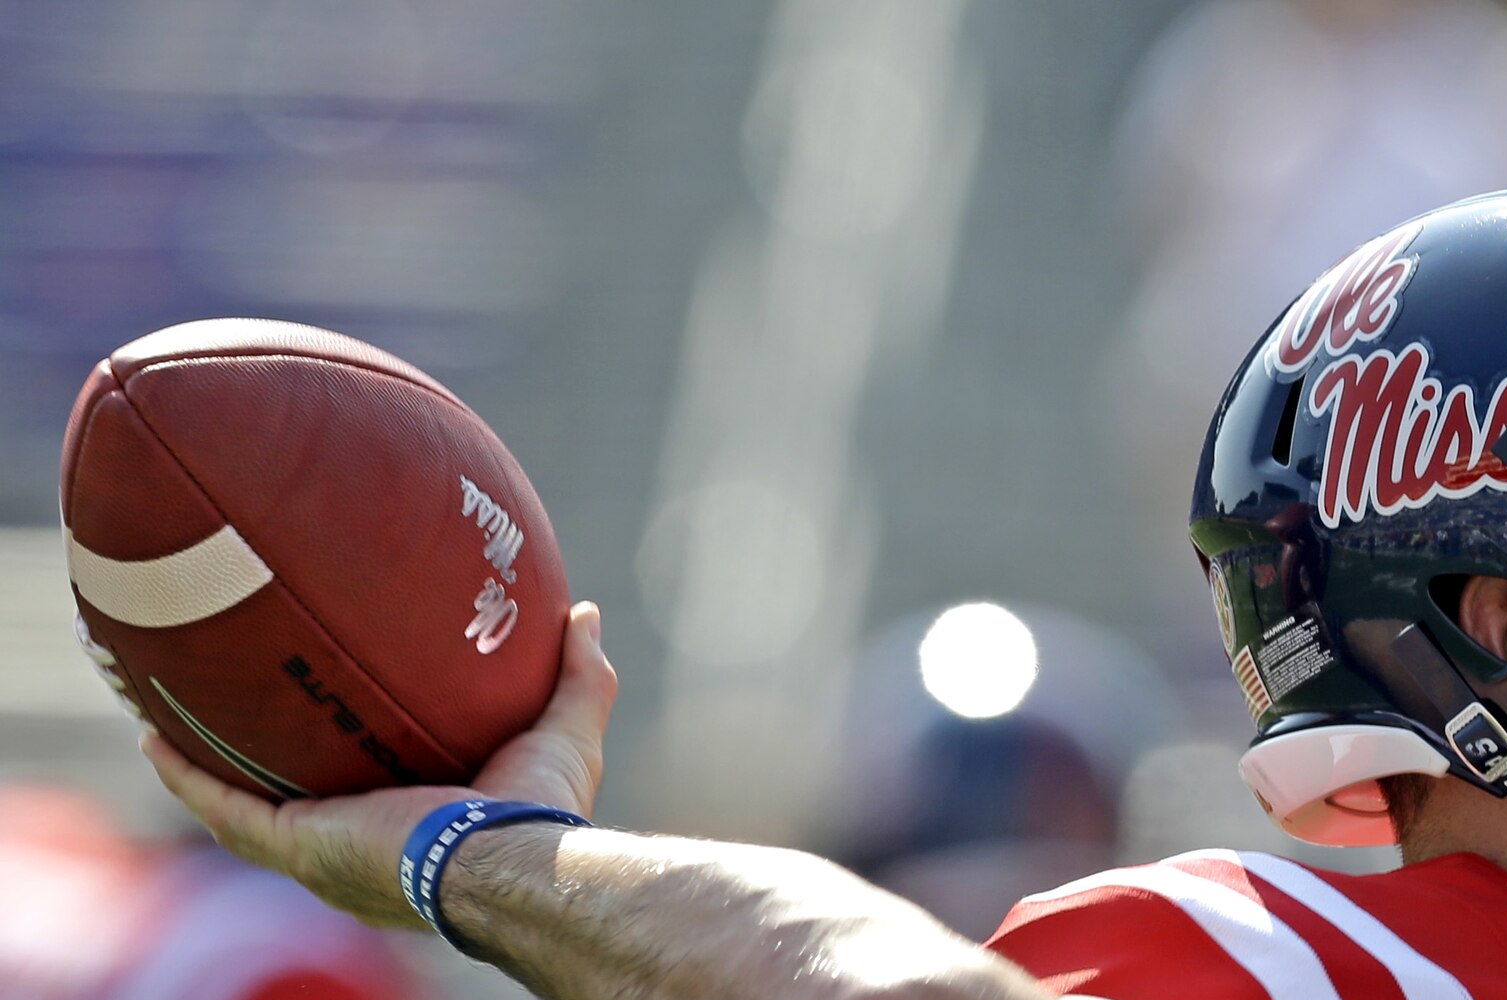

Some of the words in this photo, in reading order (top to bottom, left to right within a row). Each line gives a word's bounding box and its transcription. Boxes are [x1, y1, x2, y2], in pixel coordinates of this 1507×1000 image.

[1267, 224, 1424, 373] Ole
[460, 474, 524, 584] Miss
[464, 577, 519, 655] Ole
[1262, 616, 1296, 640] WARNING
[282, 654, 364, 735] ELITE
